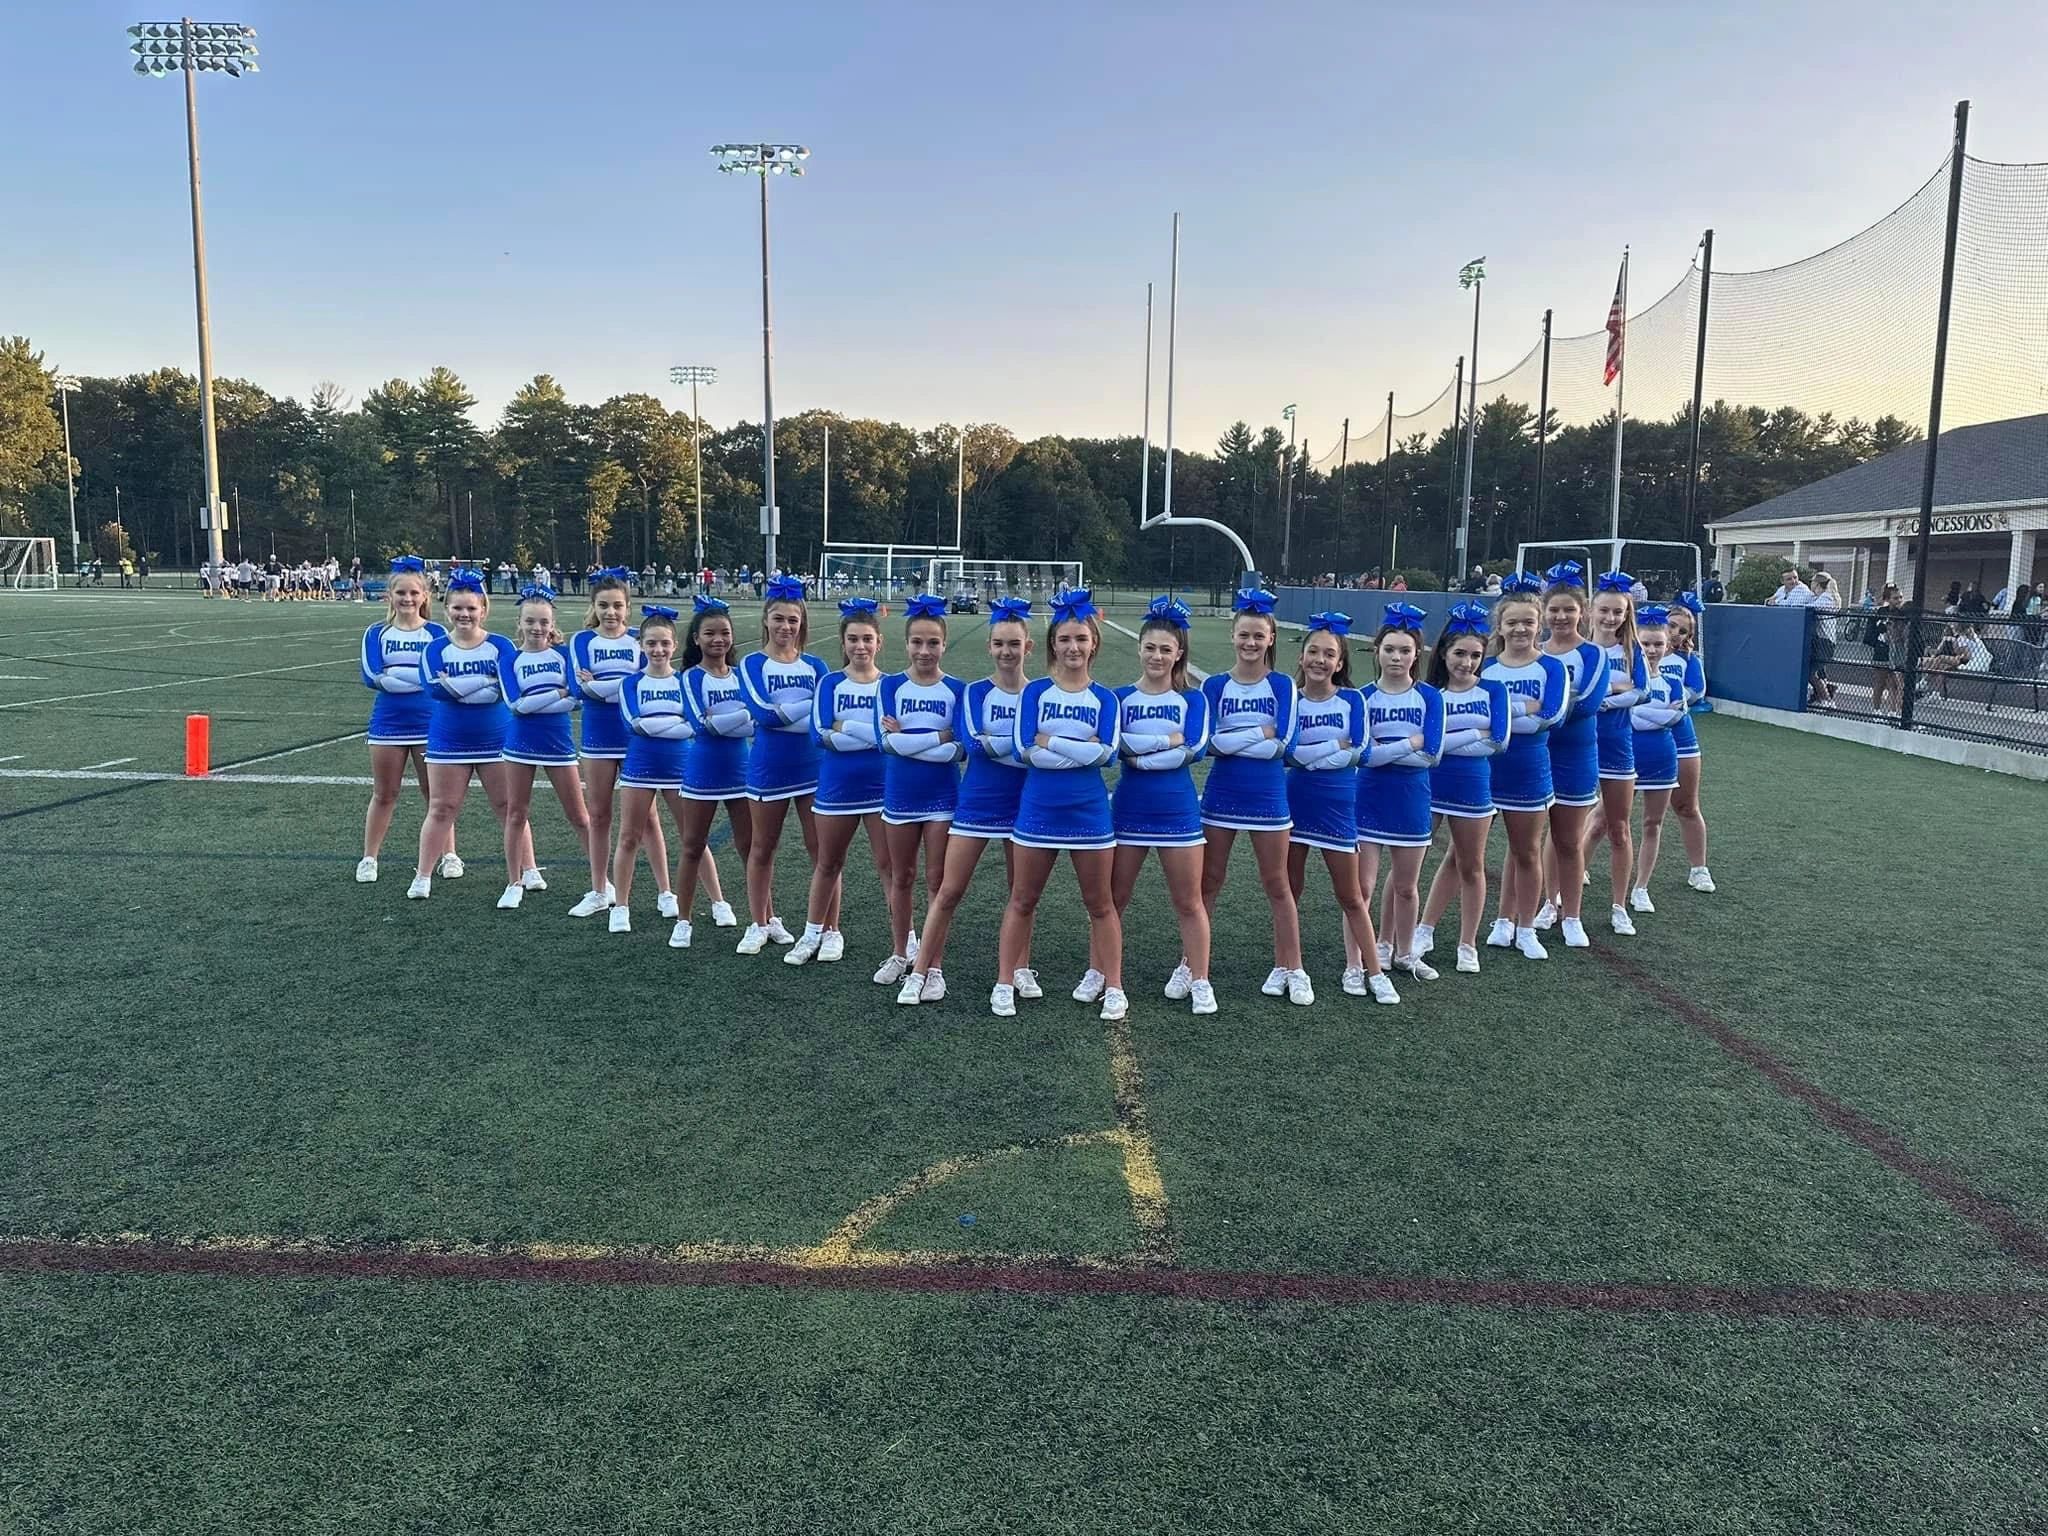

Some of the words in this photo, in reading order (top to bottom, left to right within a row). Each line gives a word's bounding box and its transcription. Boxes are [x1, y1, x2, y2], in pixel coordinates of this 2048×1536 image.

[1911, 514, 1993, 533] CNCESSIONS
[594, 649, 634, 664] FALCONS
[522, 662, 562, 679] FALCONS
[768, 675, 815, 693] FALCONS
[640, 690, 681, 704] FALCONS
[900, 698, 947, 718] FALCONS
[1041, 702, 1097, 728] FALCONS
[1126, 705, 1181, 725] FALCONS
[1222, 697, 1275, 718] FALCONS
[1369, 707, 1422, 727] FALCONS
[1299, 712, 1344, 731] FALCONS
